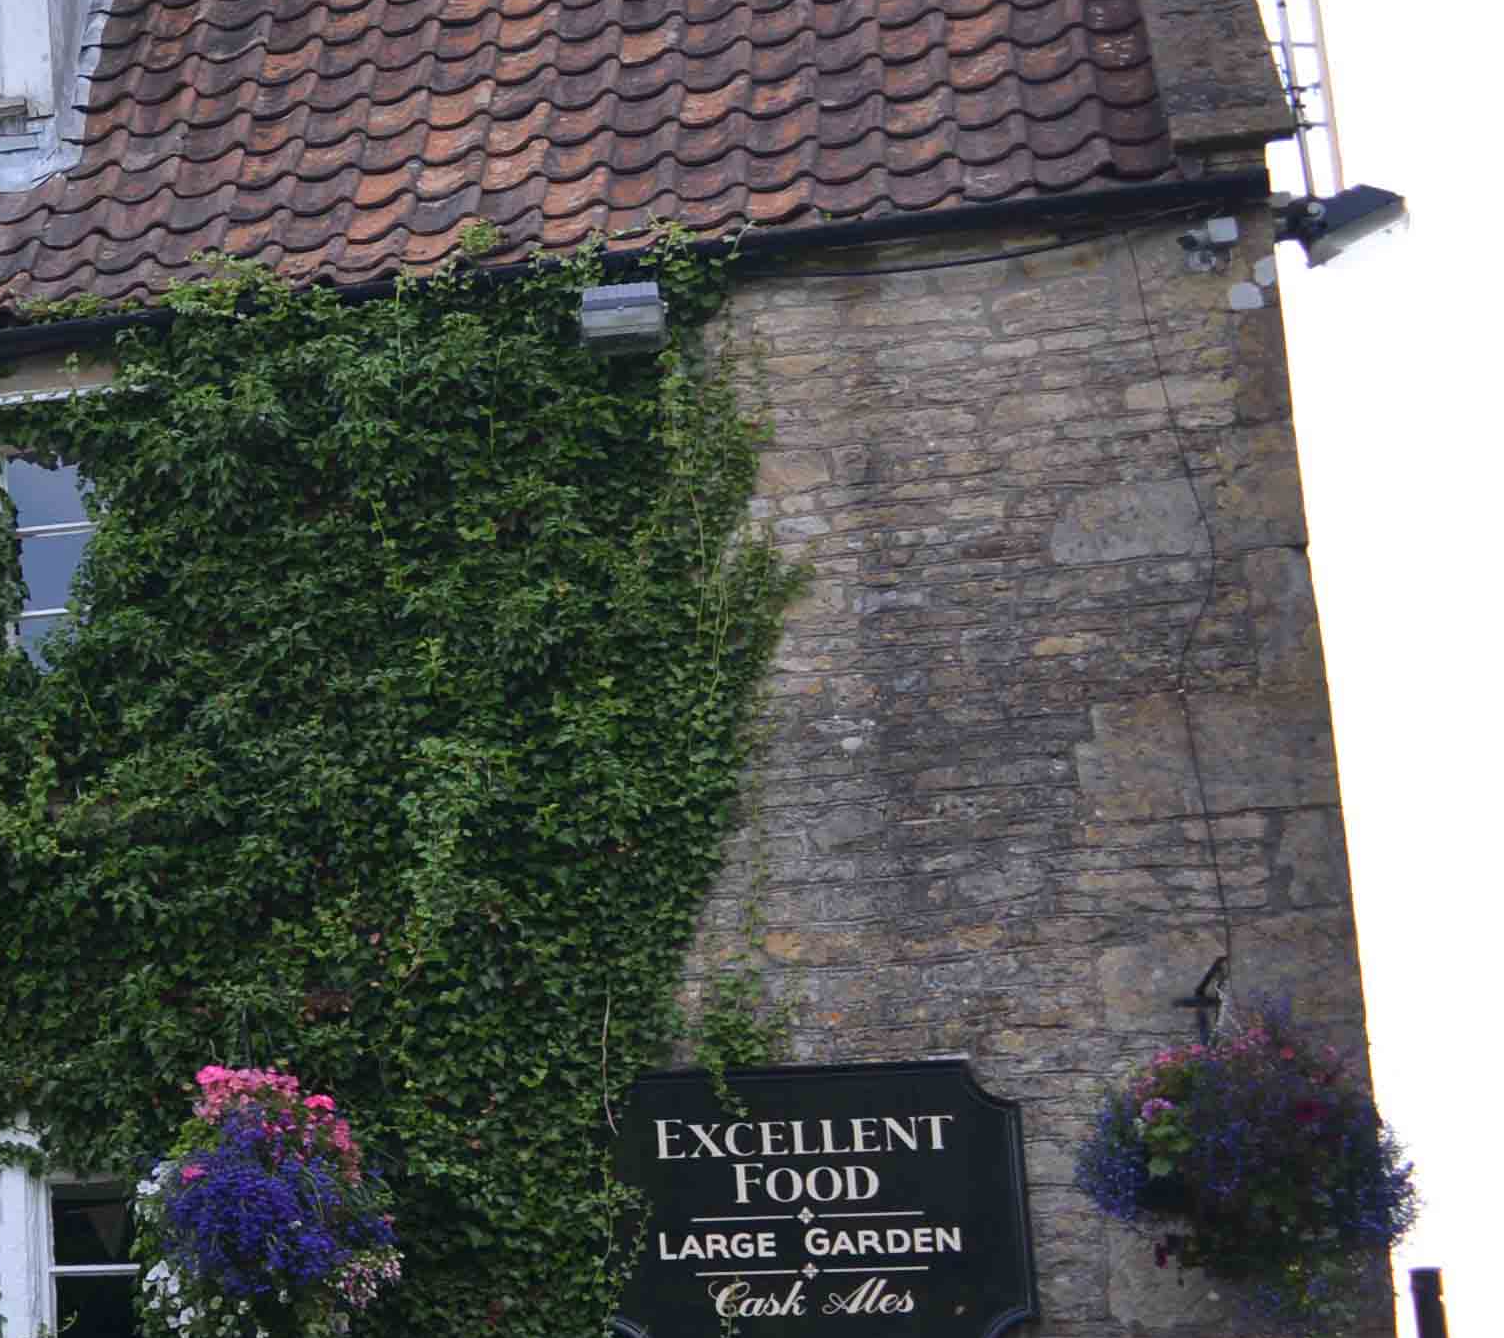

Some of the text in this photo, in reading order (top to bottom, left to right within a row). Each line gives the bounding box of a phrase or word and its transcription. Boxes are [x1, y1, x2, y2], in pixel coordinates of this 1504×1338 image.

[653, 1114, 954, 1159] EXCELLENT
[733, 1163, 880, 1204] FOOD
[658, 1227, 962, 1260] LARGE GARDEN
[707, 1276, 915, 1317] Cask Ales
